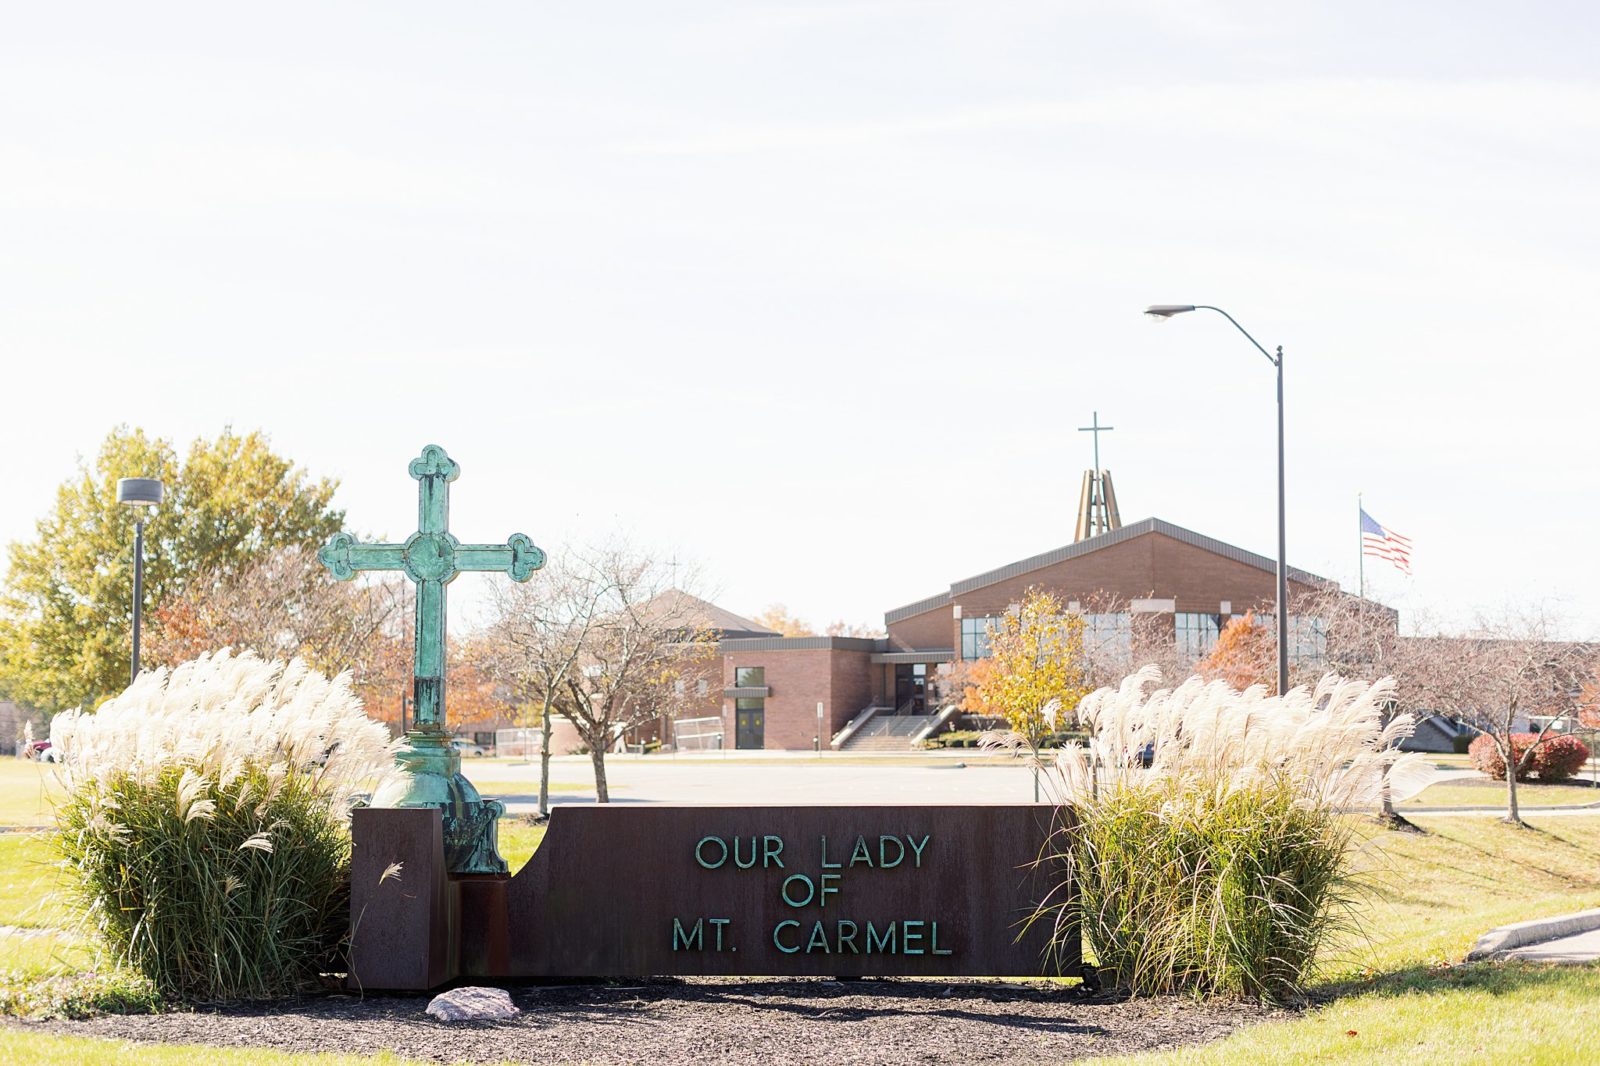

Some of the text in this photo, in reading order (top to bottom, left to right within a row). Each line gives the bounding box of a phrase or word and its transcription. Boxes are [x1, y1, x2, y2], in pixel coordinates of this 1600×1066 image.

[695, 834, 930, 869] OUR LADY
[781, 873, 842, 908] OF
[673, 918, 953, 955] MT. CARMEL
